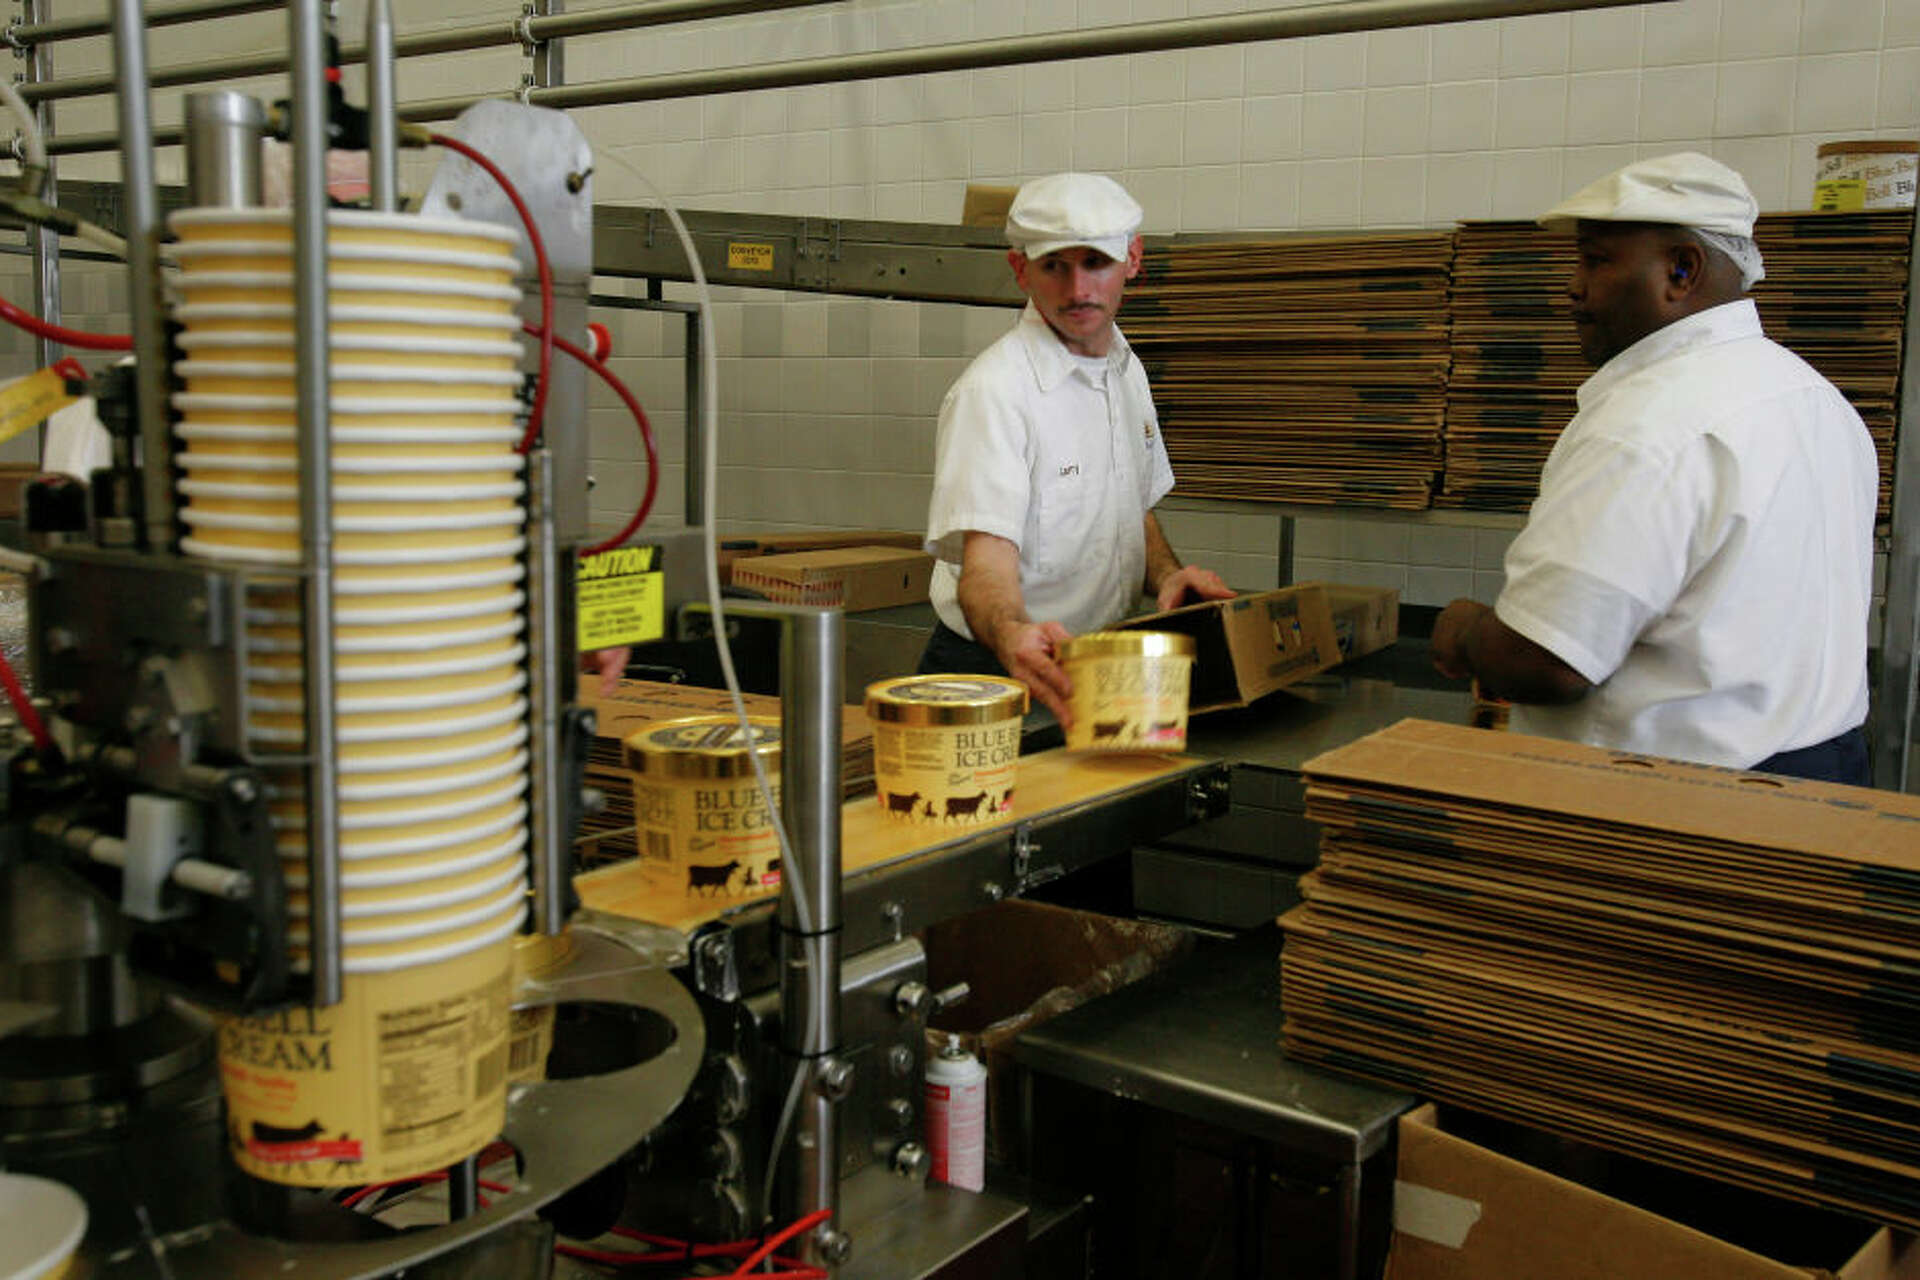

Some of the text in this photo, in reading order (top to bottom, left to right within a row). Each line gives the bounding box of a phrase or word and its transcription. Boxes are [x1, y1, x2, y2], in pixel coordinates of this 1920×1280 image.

[577, 547, 653, 579] CAUTION
[956, 728, 1006, 750] BLUE
[956, 750, 988, 769] ICE
[696, 786, 763, 811] BLUE
[697, 810, 738, 833] ICE
